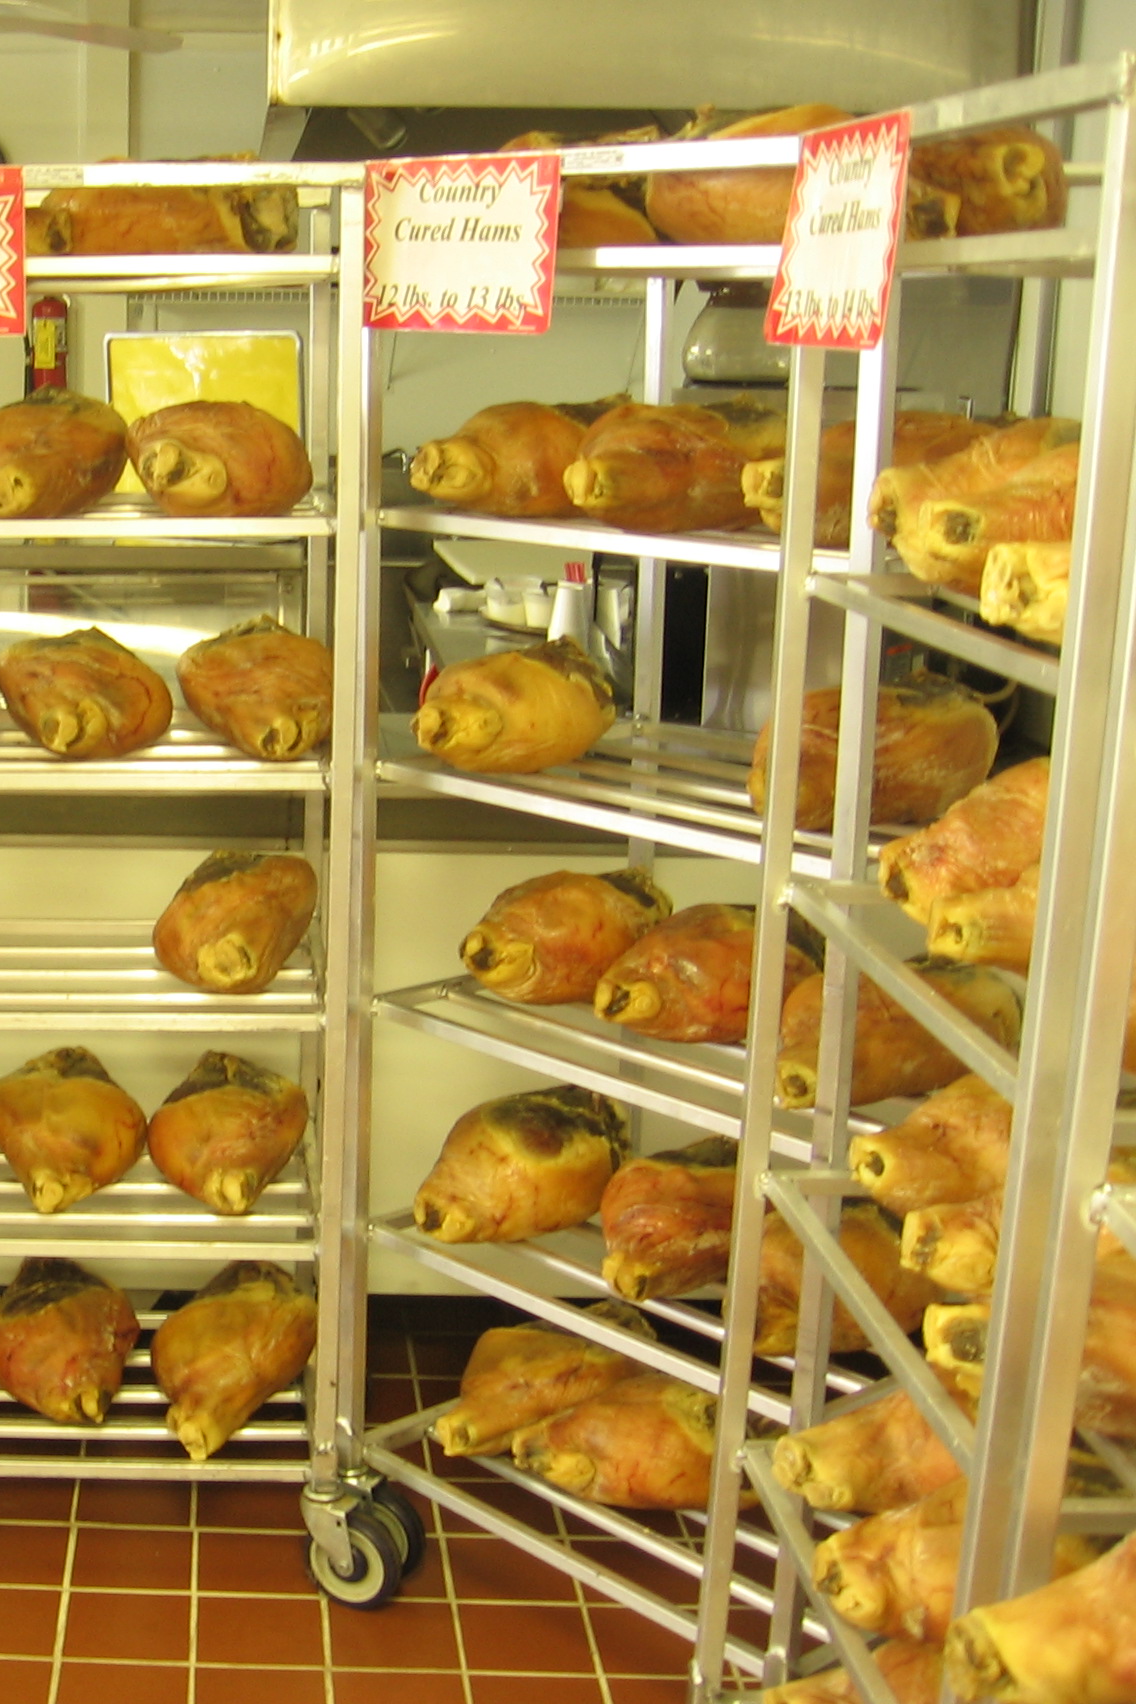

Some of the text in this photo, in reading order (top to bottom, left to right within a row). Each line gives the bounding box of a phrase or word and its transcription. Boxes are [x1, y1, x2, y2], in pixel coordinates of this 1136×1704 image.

[828, 156, 874, 188] Country
[419, 180, 502, 209] Country
[394, 217, 522, 243] Cured Hams
[810, 200, 882, 236] Cured Hams
[379, 284, 399, 308] 12
[402, 284, 432, 309] lbs.
[440, 287, 458, 309] to
[467, 286, 490, 310] 13
[785, 289, 802, 318] 13
[804, 289, 824, 318] lbs.
[827, 291, 840, 318] to
[842, 289, 855, 320] 14
